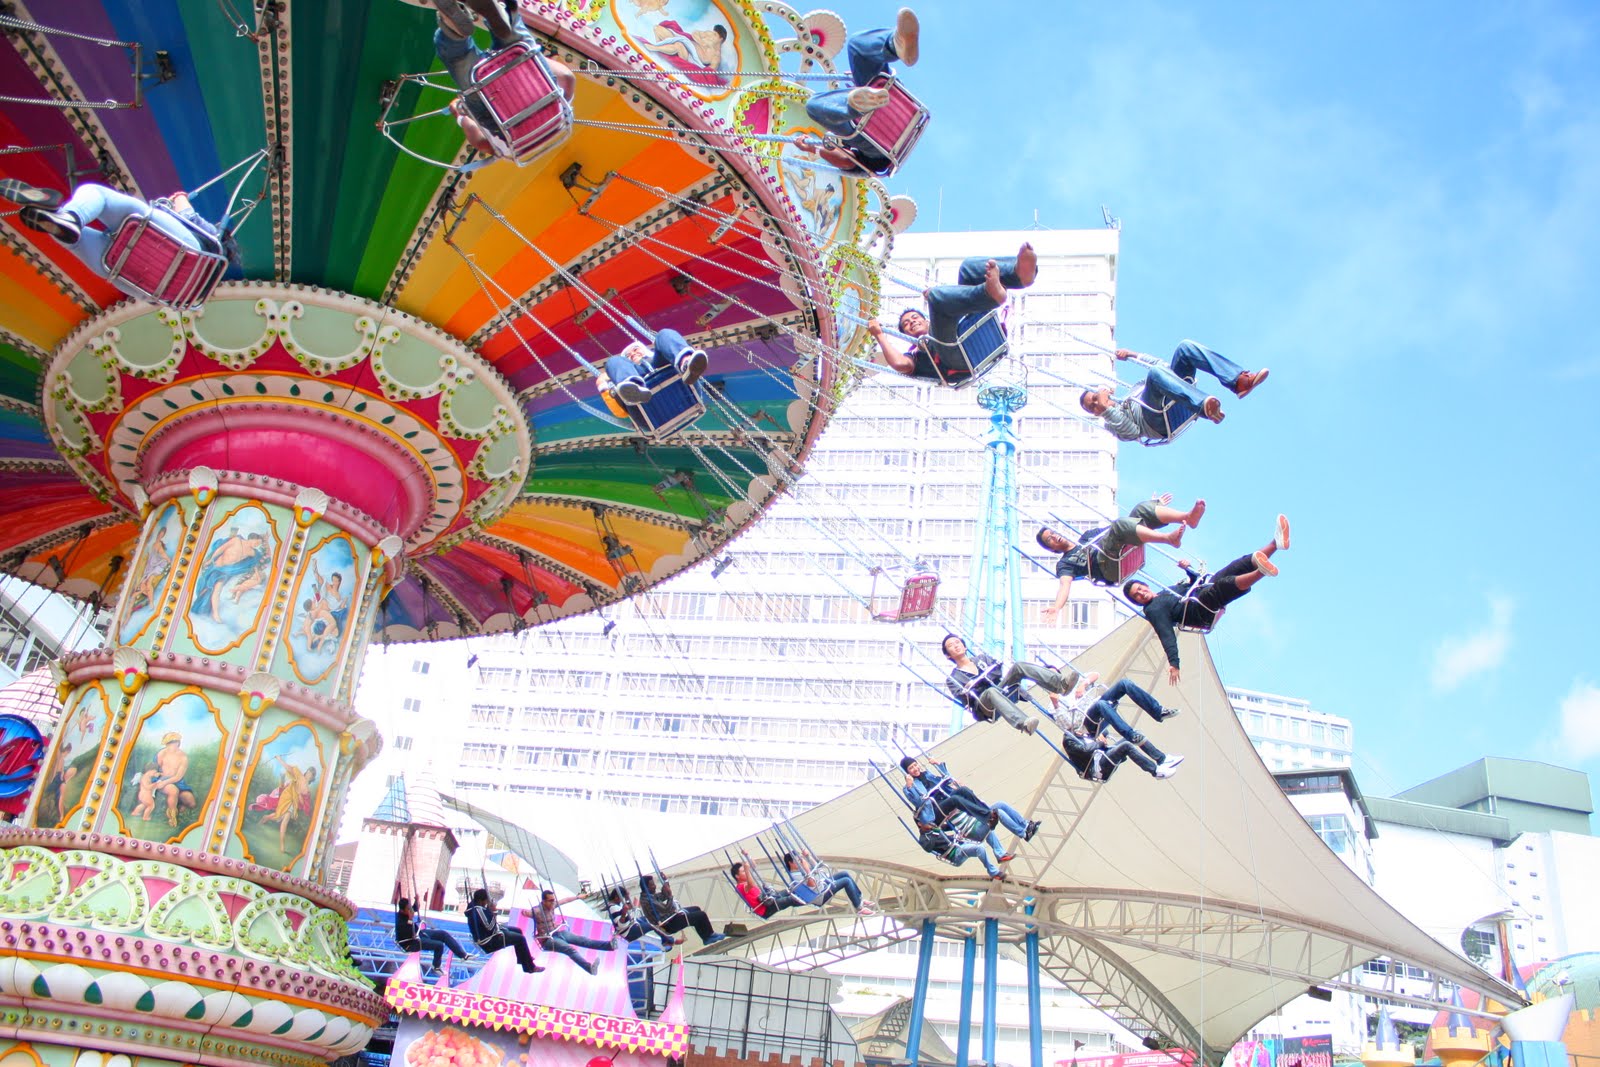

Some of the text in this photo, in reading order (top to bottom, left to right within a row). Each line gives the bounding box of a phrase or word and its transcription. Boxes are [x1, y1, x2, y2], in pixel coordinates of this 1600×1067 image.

[404, 986, 476, 1009] SWEET
[479, 998, 538, 1019] CORN
[553, 1009, 589, 1028] ICE
[592, 1017, 667, 1040] CREAM
